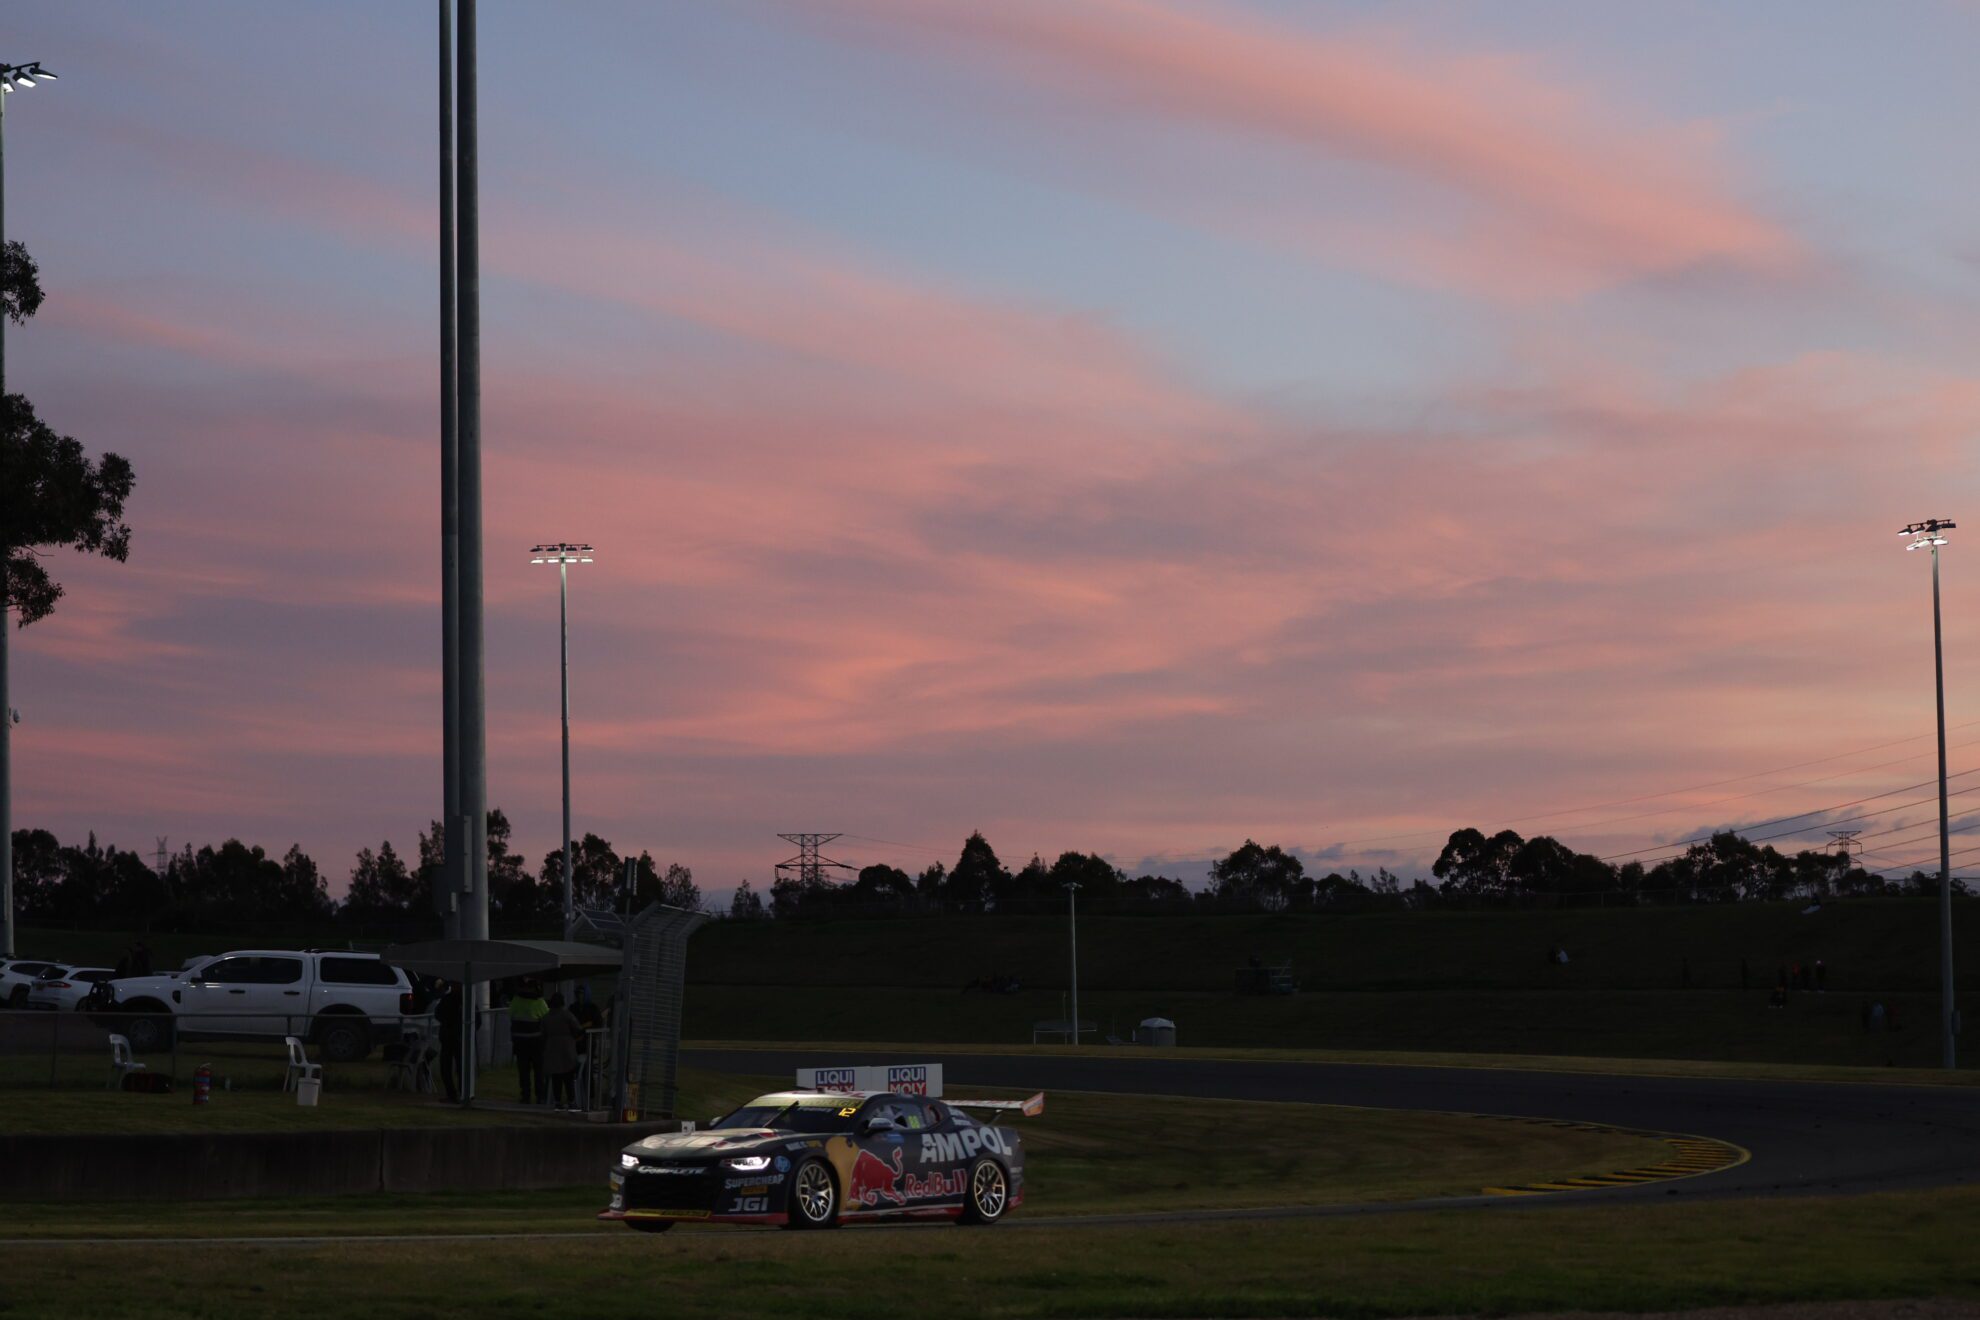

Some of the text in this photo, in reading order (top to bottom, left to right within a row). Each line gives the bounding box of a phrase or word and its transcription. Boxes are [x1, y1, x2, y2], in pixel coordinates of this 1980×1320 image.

[817, 1070, 854, 1084] LIQUI
[889, 1068, 925, 1082] LIQUI
[890, 1082, 926, 1096] MOLY
[920, 1126, 1012, 1163] AMPOL
[724, 1174, 785, 1189] SUPERCHEAP
[728, 1197, 769, 1212] JGI
